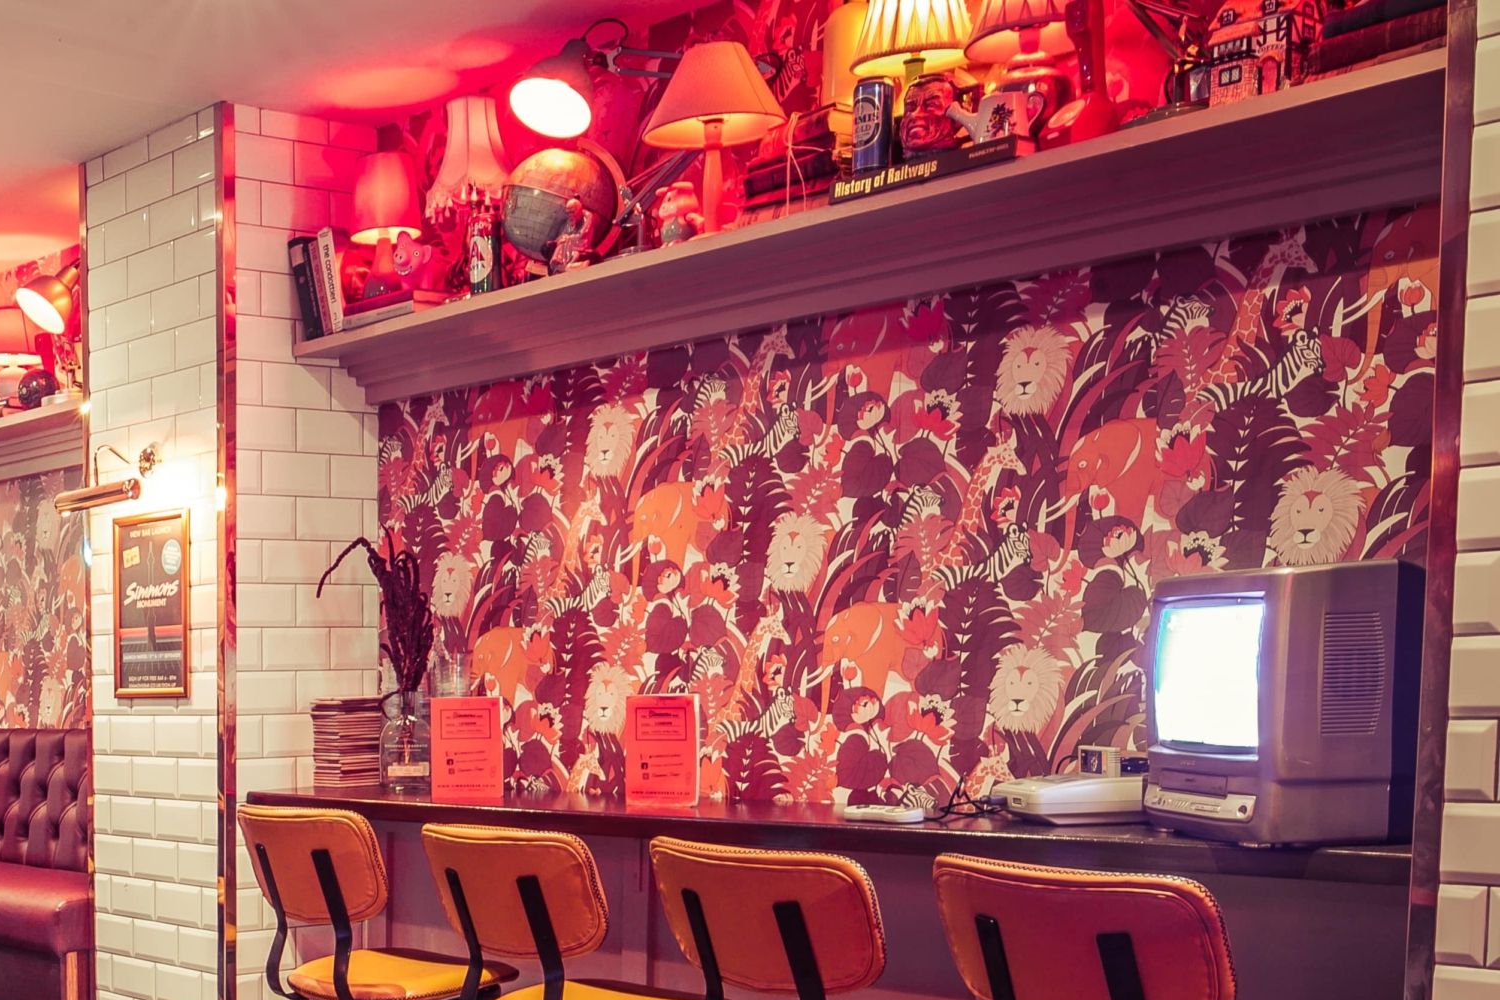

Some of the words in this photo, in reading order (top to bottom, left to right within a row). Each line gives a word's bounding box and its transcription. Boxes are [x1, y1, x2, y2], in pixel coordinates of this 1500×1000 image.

[834, 176, 872, 198] History
[873, 173, 885, 188] of
[887, 159, 938, 185] Railways
[322, 244, 330, 256] the
